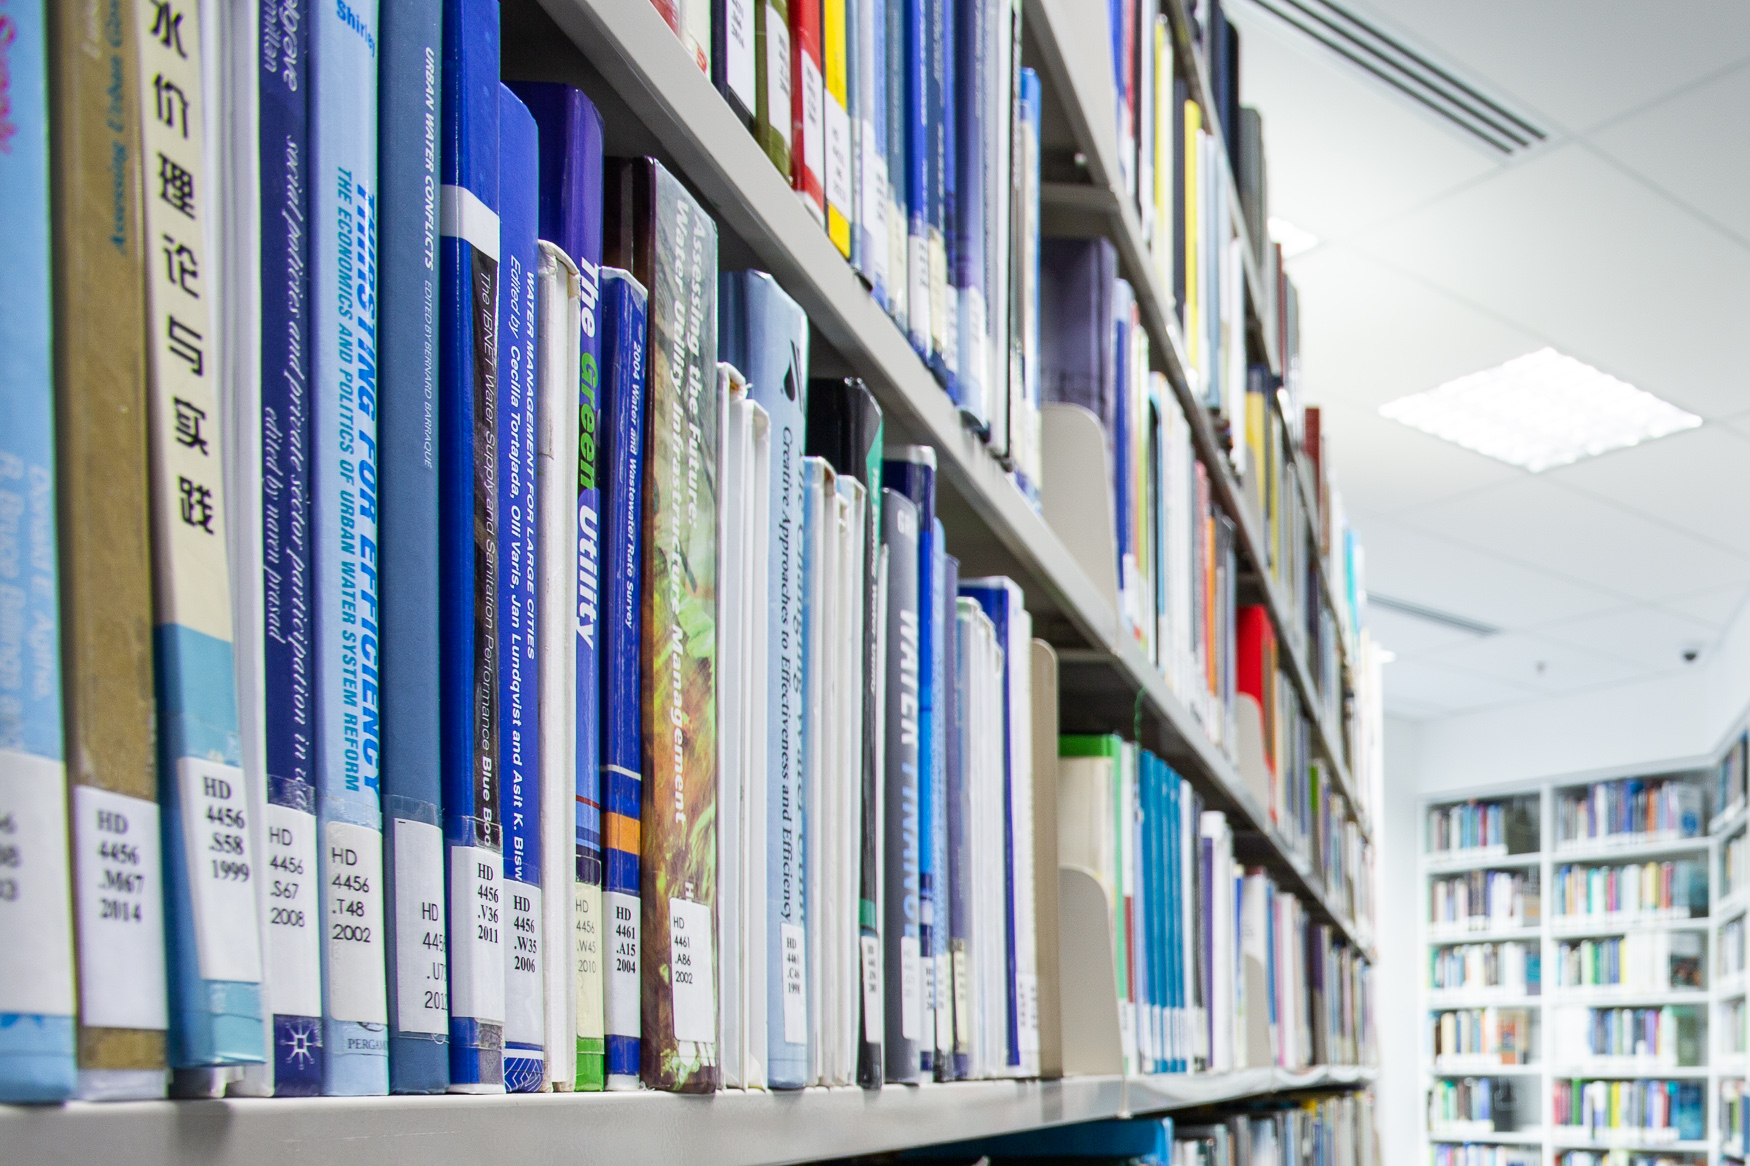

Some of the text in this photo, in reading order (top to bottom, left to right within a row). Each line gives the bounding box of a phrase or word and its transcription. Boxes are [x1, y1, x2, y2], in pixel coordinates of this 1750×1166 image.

[337, 1, 376, 58] Shirley
[285, 135, 303, 221] social
[425, 47, 434, 271] URBAN WATER CONFLICTS
[150, 0, 216, 536] 水价理论与实践
[282, 208, 303, 318] policies
[289, 322, 305, 381] and
[424, 280, 432, 468] EDITED BY BERNARD BARRAQUÉ
[633, 341, 641, 380] 2004
[687, 215, 705, 528] Assessing the Future:
[284, 369, 304, 472] private
[576, 257, 599, 650] The Green Utility
[630, 428, 638, 455] and
[631, 384, 640, 425] Water
[263, 407, 286, 643] edited by naren prasad
[290, 475, 305, 551] sector
[338, 167, 359, 791] THE ECONOMICS AND POLITICS OF URBAN WATER SYSTEM REFORM
[357, 184, 379, 799] THIRSTING FOR EFFICIENCY
[628, 458, 637, 540] Wastewater
[671, 200, 689, 824] Water Utility Infrastructure Management
[480, 272, 496, 847] The IBNET Water Supply and Sanitation Performance Blue Boo
[509, 255, 523, 881] Edited by Cecilia Tortajada, Olli Varis, Jan Lundqvist and Asit K. Bisw
[625, 581, 634, 628] Survey
[286, 547, 308, 724] participation
[779, 426, 792, 921] Creative Approaches to Effectiveness and Efficiency
[294, 734, 309, 760] in
[332, 847, 357, 866] HD
[332, 873, 369, 893] 4456
[332, 899, 364, 917] .T48
[332, 923, 371, 943] 2002
